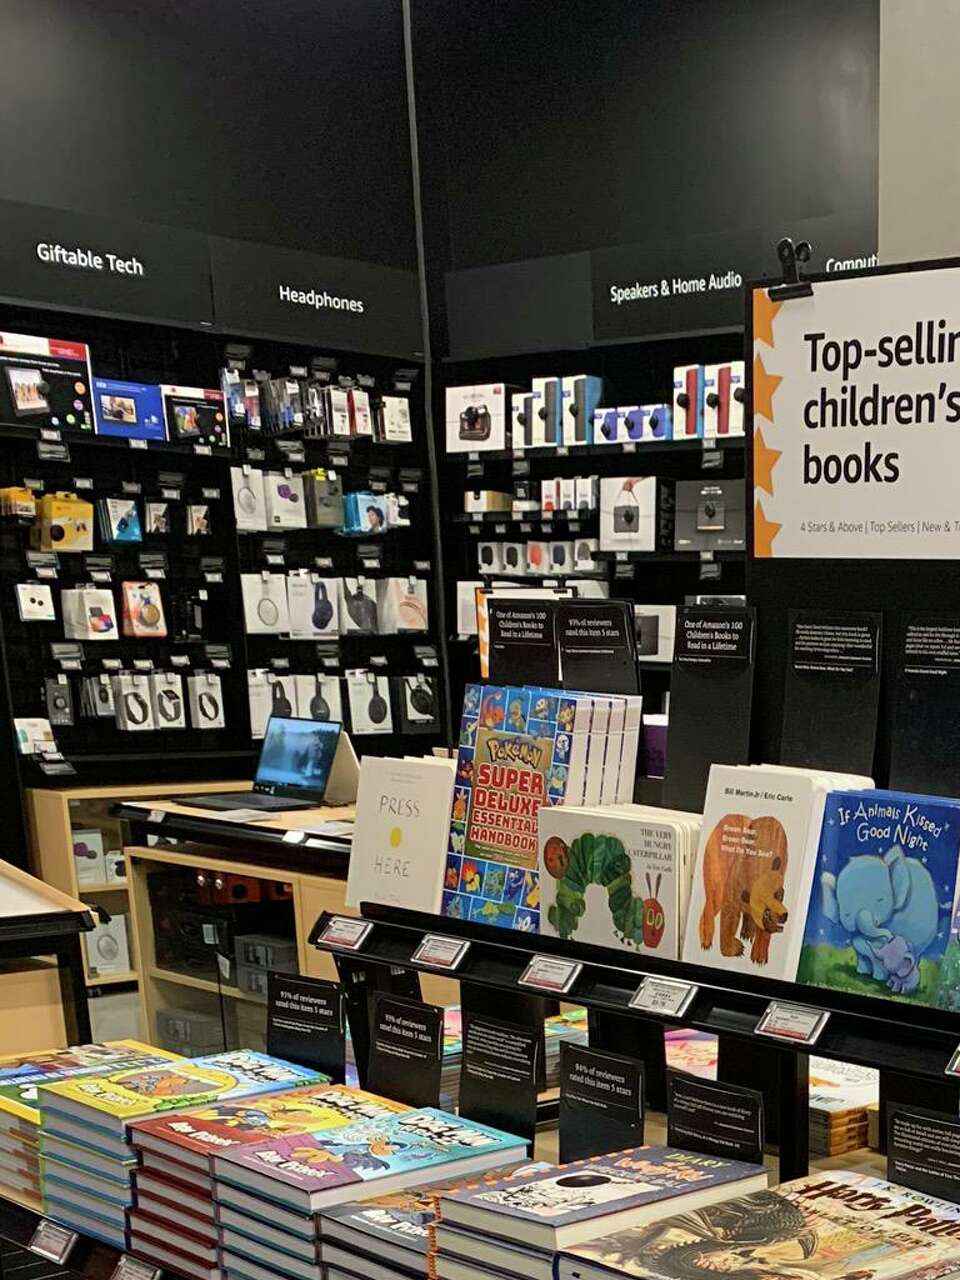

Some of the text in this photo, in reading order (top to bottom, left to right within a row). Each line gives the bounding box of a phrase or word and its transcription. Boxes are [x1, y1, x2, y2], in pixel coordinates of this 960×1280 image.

[37, 243, 144, 276] Giftable Tech
[826, 255, 879, 273] Comput
[279, 285, 364, 313] Headphones
[610, 271, 743, 304] Speakers & Home Audio
[804, 441, 900, 484] books
[800, 521, 806, 532] 4
[807, 521, 828, 533] Stars
[829, 521, 836, 532] &
[838, 521, 863, 532] Above
[870, 521, 886, 534] Top
[887, 521, 915, 532] Sellers
[922, 521, 941, 532] New
[944, 521, 950, 532] &
[478, 763, 545, 795] SUPER
[379, 795, 421, 818] PRESS
[474, 788, 542, 817] DELUXE
[724, 788, 734, 796] Bill
[735, 789, 753, 797] Martin
[764, 792, 775, 800] Eric
[776, 793, 793, 801] Carle
[472, 809, 538, 834] ESSENTIAL
[838, 801, 943, 839] If Animals Kissed
[470, 827, 538, 851] HANDBOOK
[640, 828, 672, 839] THE VERY
[643, 840, 672, 850] HUNGRY
[857, 822, 929, 852] Good Night
[629, 850, 673, 862] CATERPILLAR
[745, 847, 757, 855] You
[758, 848, 774, 857] See?
[373, 856, 412, 878] HERE
[665, 1153, 732, 1168] DIARY
[795, 1180, 895, 1212] Harry
